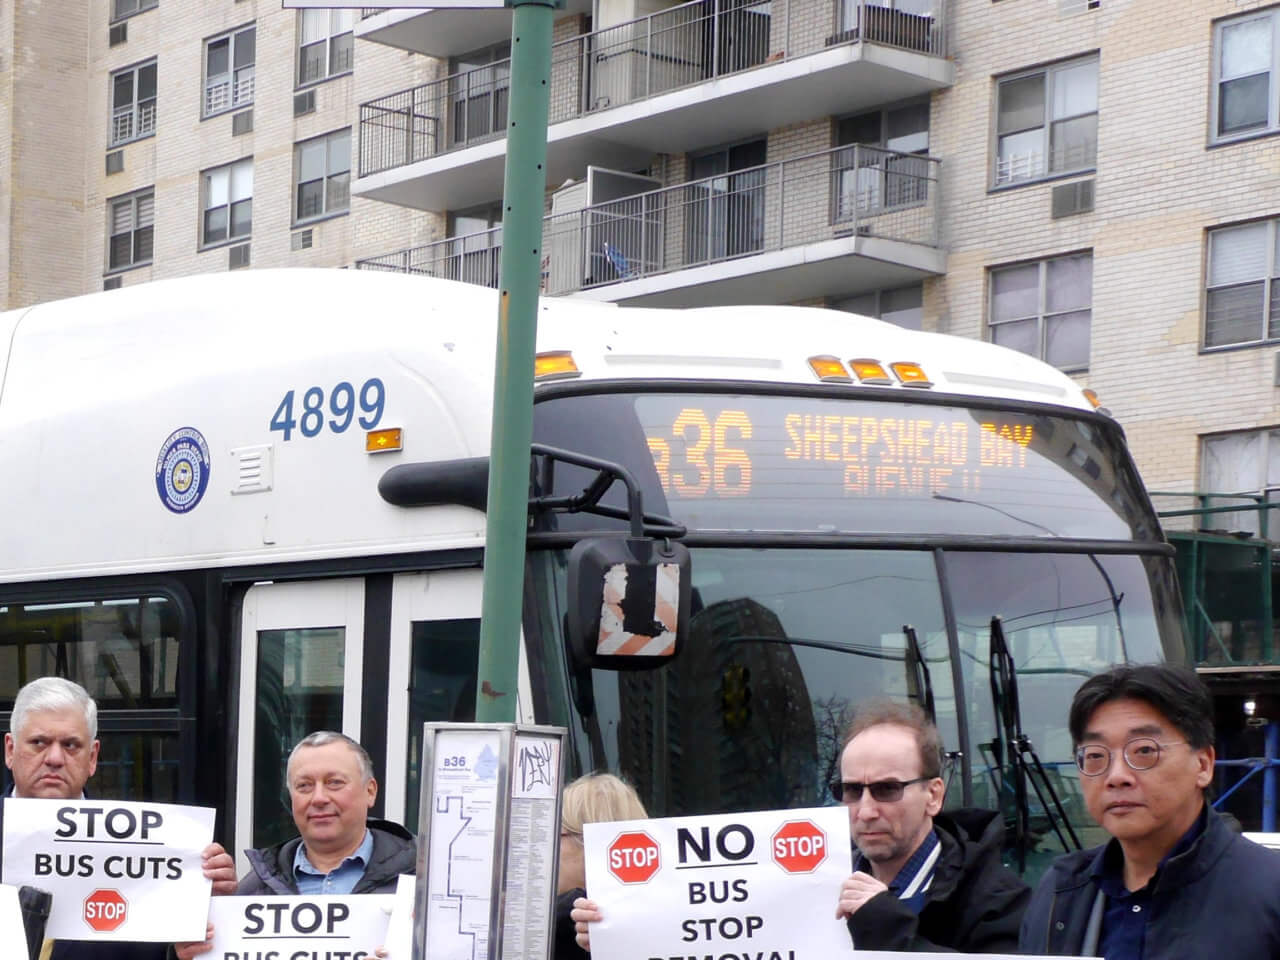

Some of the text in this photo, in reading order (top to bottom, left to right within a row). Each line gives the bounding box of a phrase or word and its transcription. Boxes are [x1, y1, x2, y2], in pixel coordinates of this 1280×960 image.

[270, 377, 386, 441] 4899
[784, 414, 968, 465] SHEEPSHEAD
[980, 423, 1033, 467] BAY
[444, 756, 466, 767] B36
[55, 807, 163, 839] STOP
[611, 824, 824, 869] STOP NO STOP
[35, 853, 183, 880] BUS CUTS
[689, 879, 748, 904] BUS
[86, 902, 126, 919] STOP
[243, 902, 350, 934] STOP
[682, 916, 764, 942] STOP
